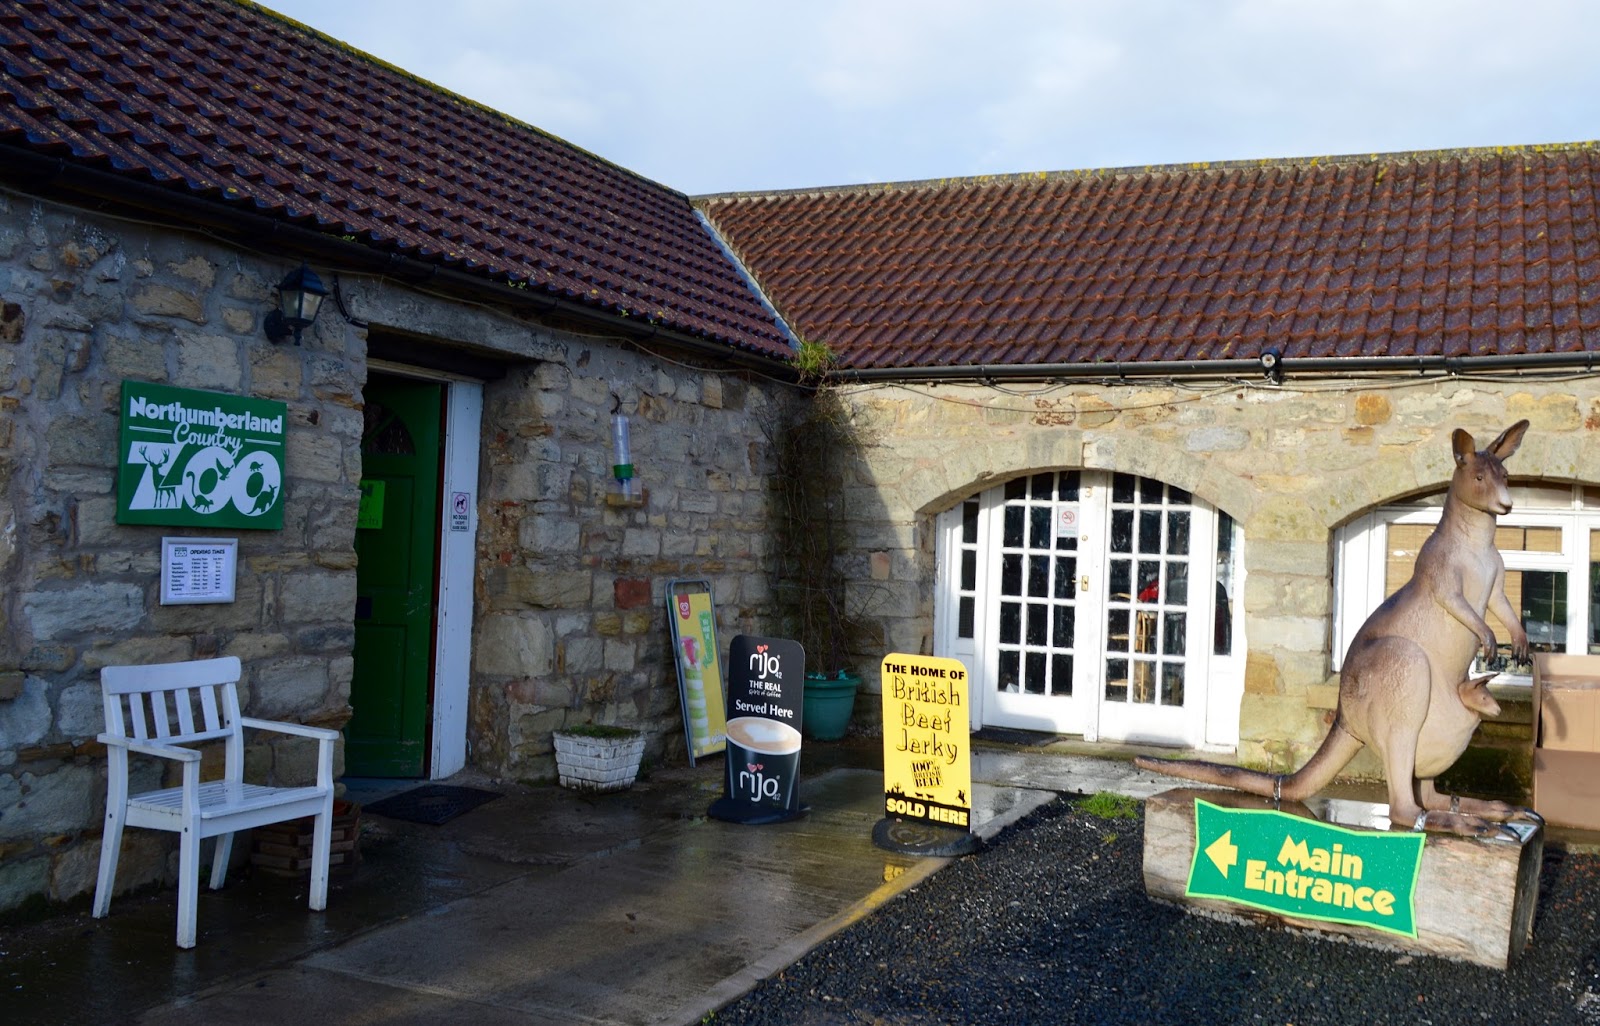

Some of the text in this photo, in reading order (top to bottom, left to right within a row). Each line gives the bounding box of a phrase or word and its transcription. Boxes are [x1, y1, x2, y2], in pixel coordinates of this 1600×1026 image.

[128, 395, 283, 434] Northumberland
[173, 421, 243, 459] Country
[127, 441, 281, 517] ZOO
[749, 652, 780, 680] rijo
[774, 671, 783, 679] 42
[884, 663, 965, 680] THE HOME OF
[749, 680, 782, 692] THE REAL
[891, 675, 960, 706] British
[735, 699, 794, 718] Served Here
[901, 702, 951, 734] Beef
[896, 728, 958, 765] Jerky
[740, 770, 779, 802] rijo
[915, 777, 942, 787] BEEF
[886, 798, 968, 826] SOLD HERE
[1277, 834, 1363, 880] Main
[1244, 859, 1396, 916] Entrance
